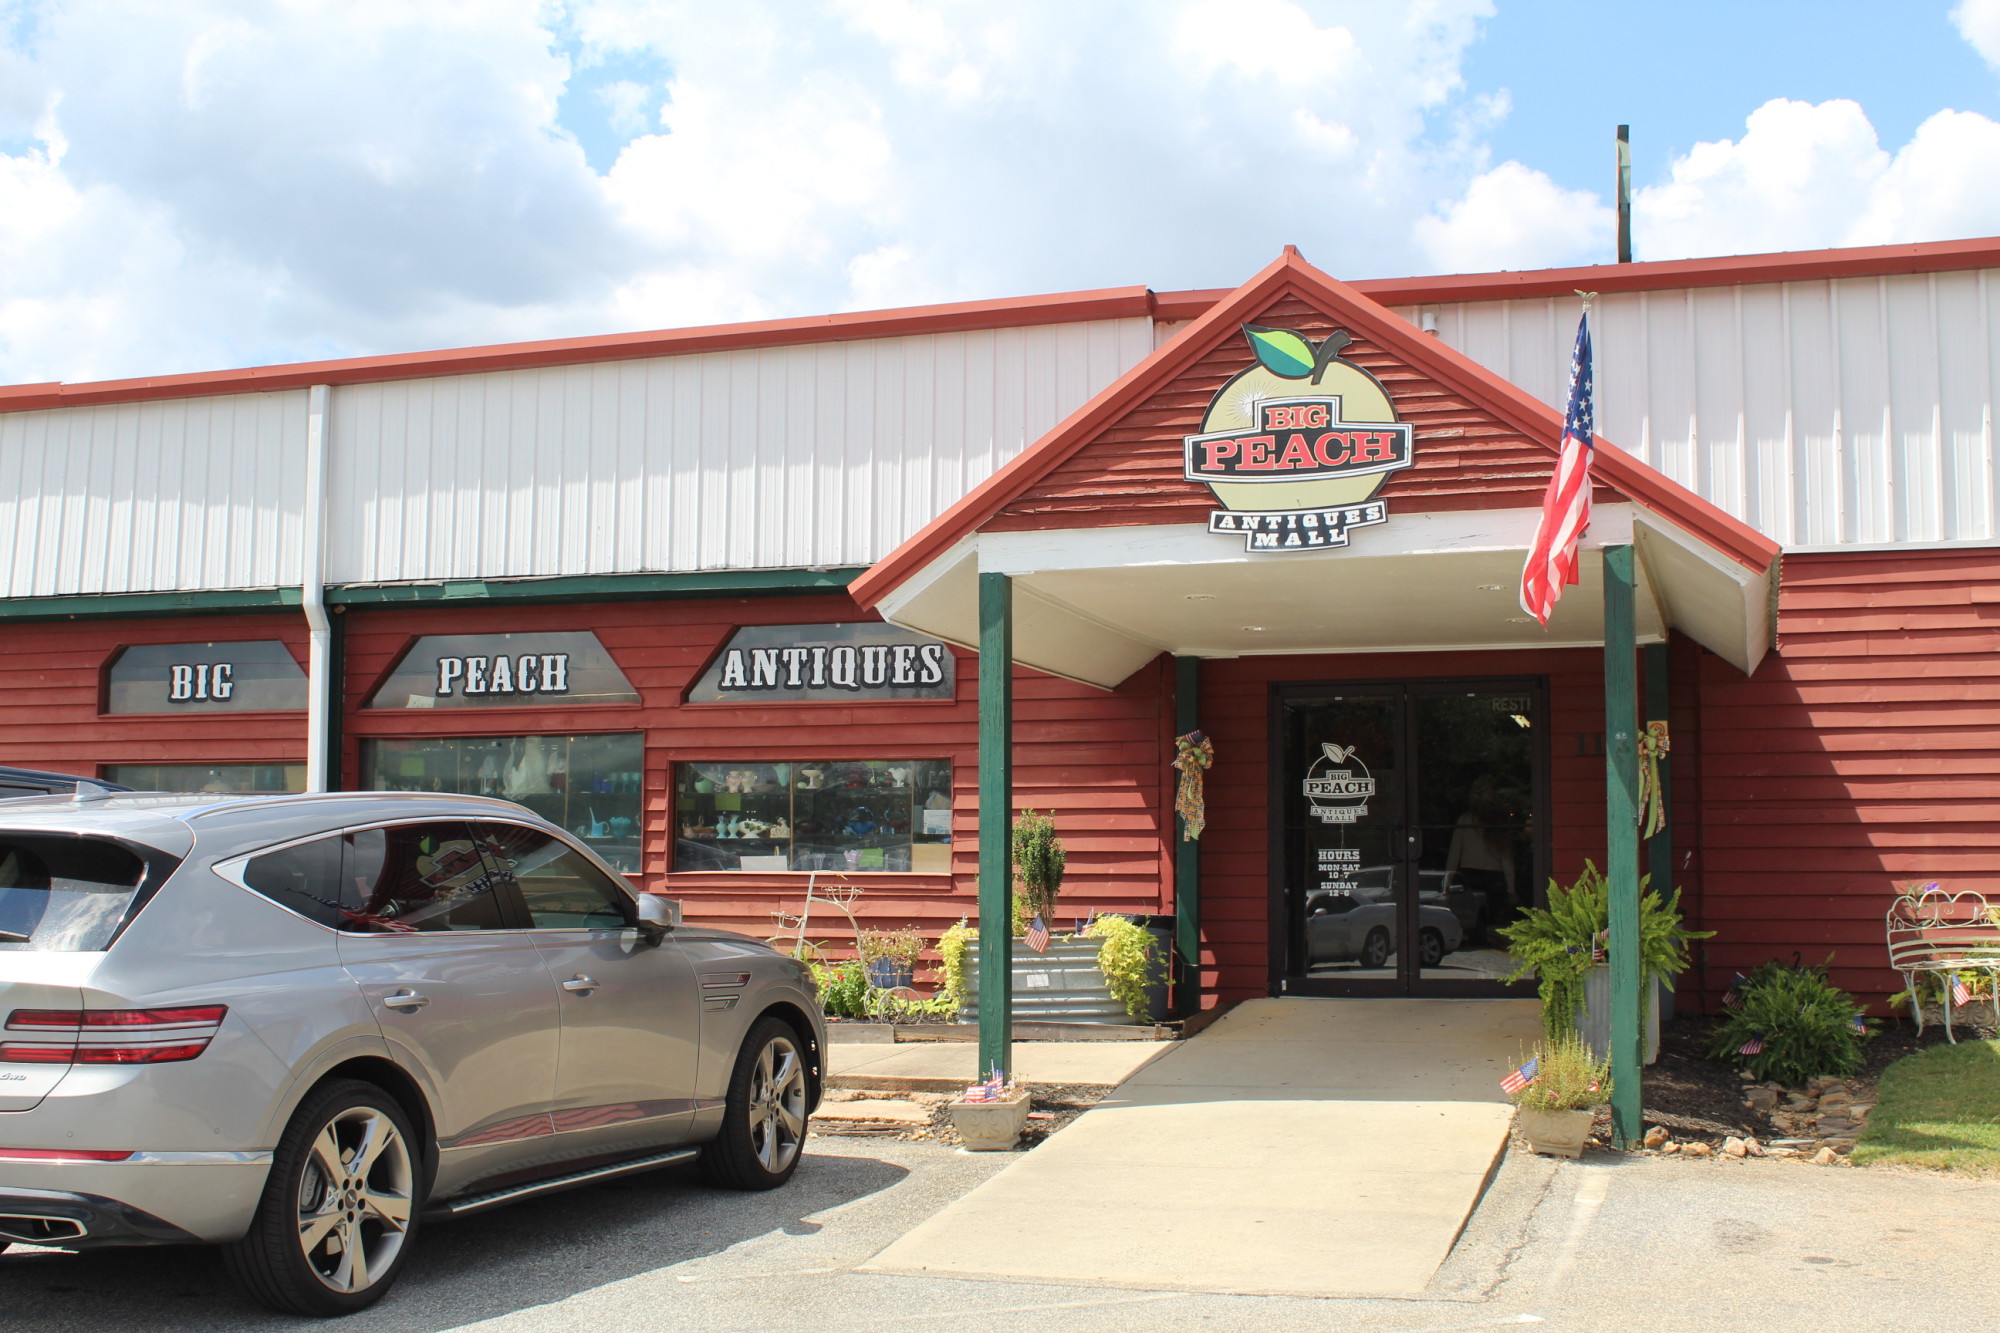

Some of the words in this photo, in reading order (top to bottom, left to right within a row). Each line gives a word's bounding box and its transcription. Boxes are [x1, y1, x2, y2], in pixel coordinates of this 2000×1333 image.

[1265, 405, 1330, 430] BIG
[1200, 432, 1397, 471] PEACH
[1219, 507, 1381, 529] ANTIQUES
[1255, 529, 1346, 547] MALL
[170, 663, 233, 700] BIG
[437, 654, 569, 695] PEACH
[720, 644, 944, 689] ANTIQUES
[1330, 773, 1348, 781] BIG
[1307, 782, 1371, 794] PEACH
[1318, 850, 1360, 860] HOURS
